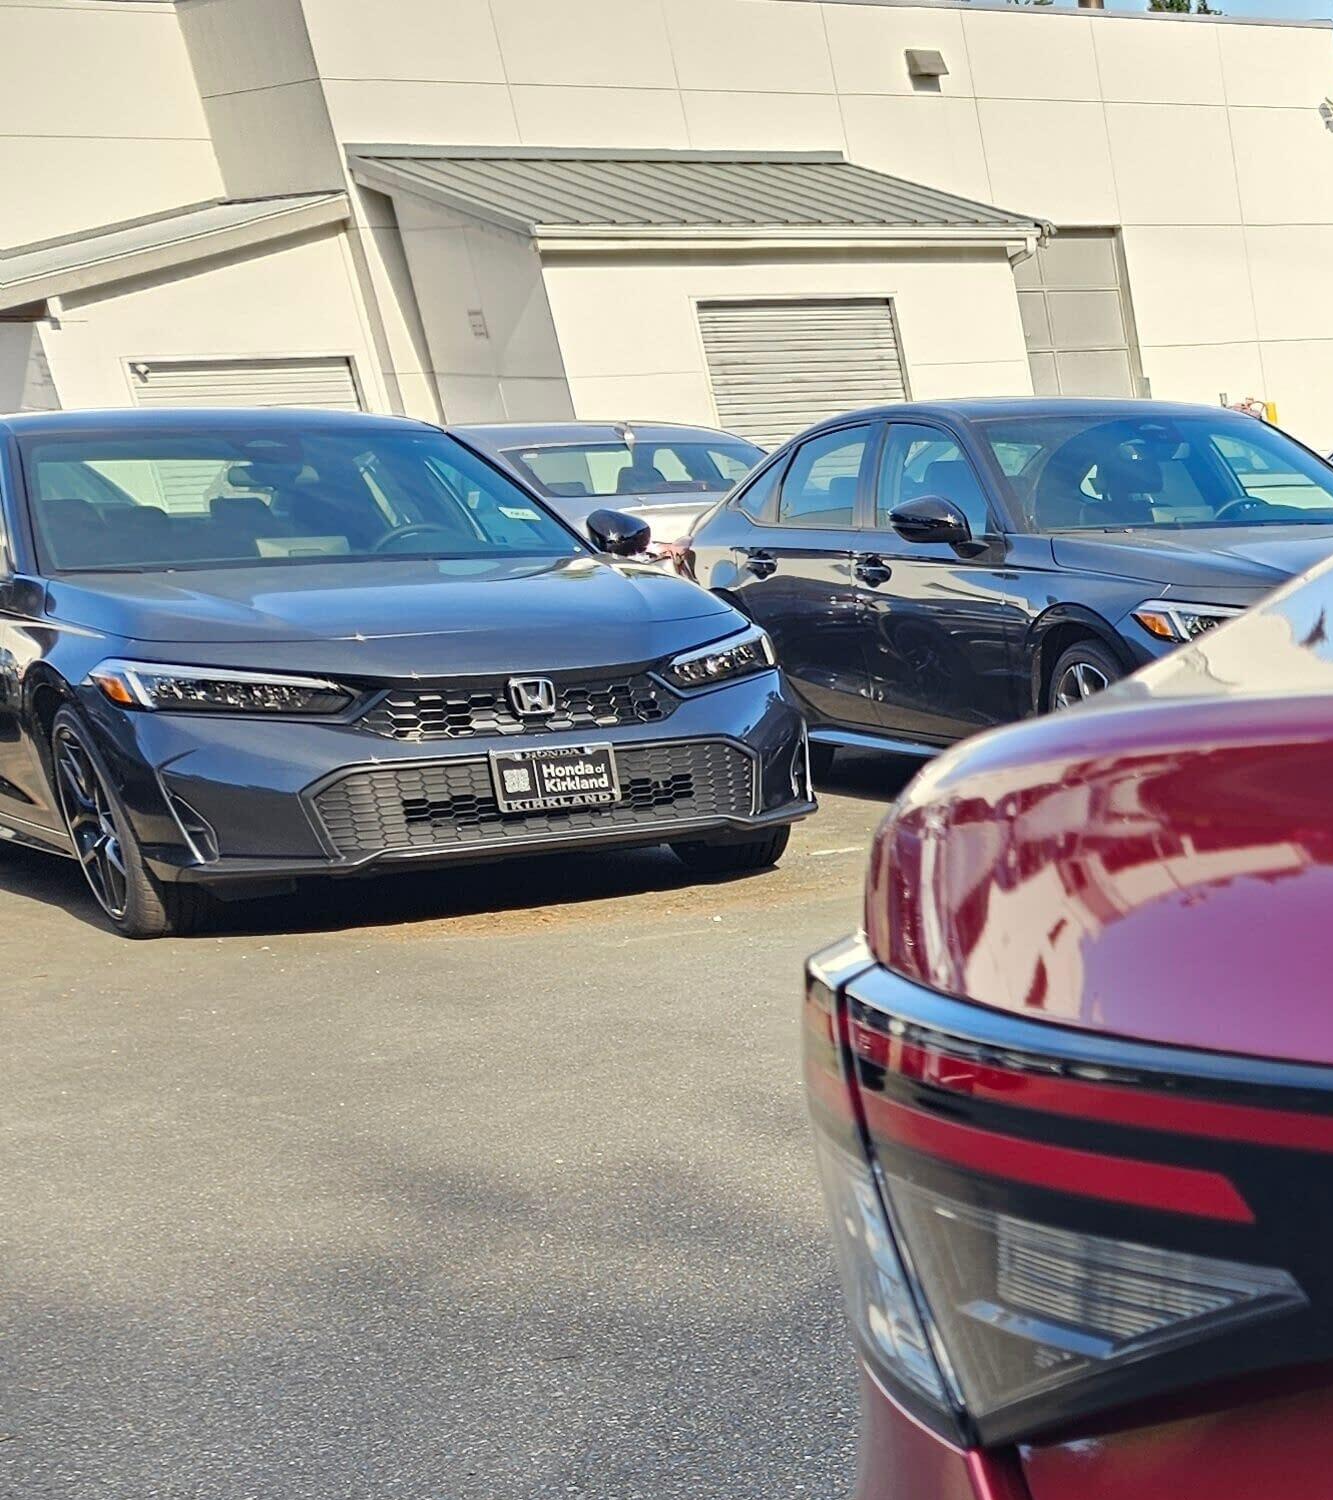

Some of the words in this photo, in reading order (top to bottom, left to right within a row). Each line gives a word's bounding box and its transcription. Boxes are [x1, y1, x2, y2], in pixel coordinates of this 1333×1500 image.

[541, 760, 594, 778] Honda
[595, 763, 605, 773] of
[544, 774, 608, 792] Kirkland
